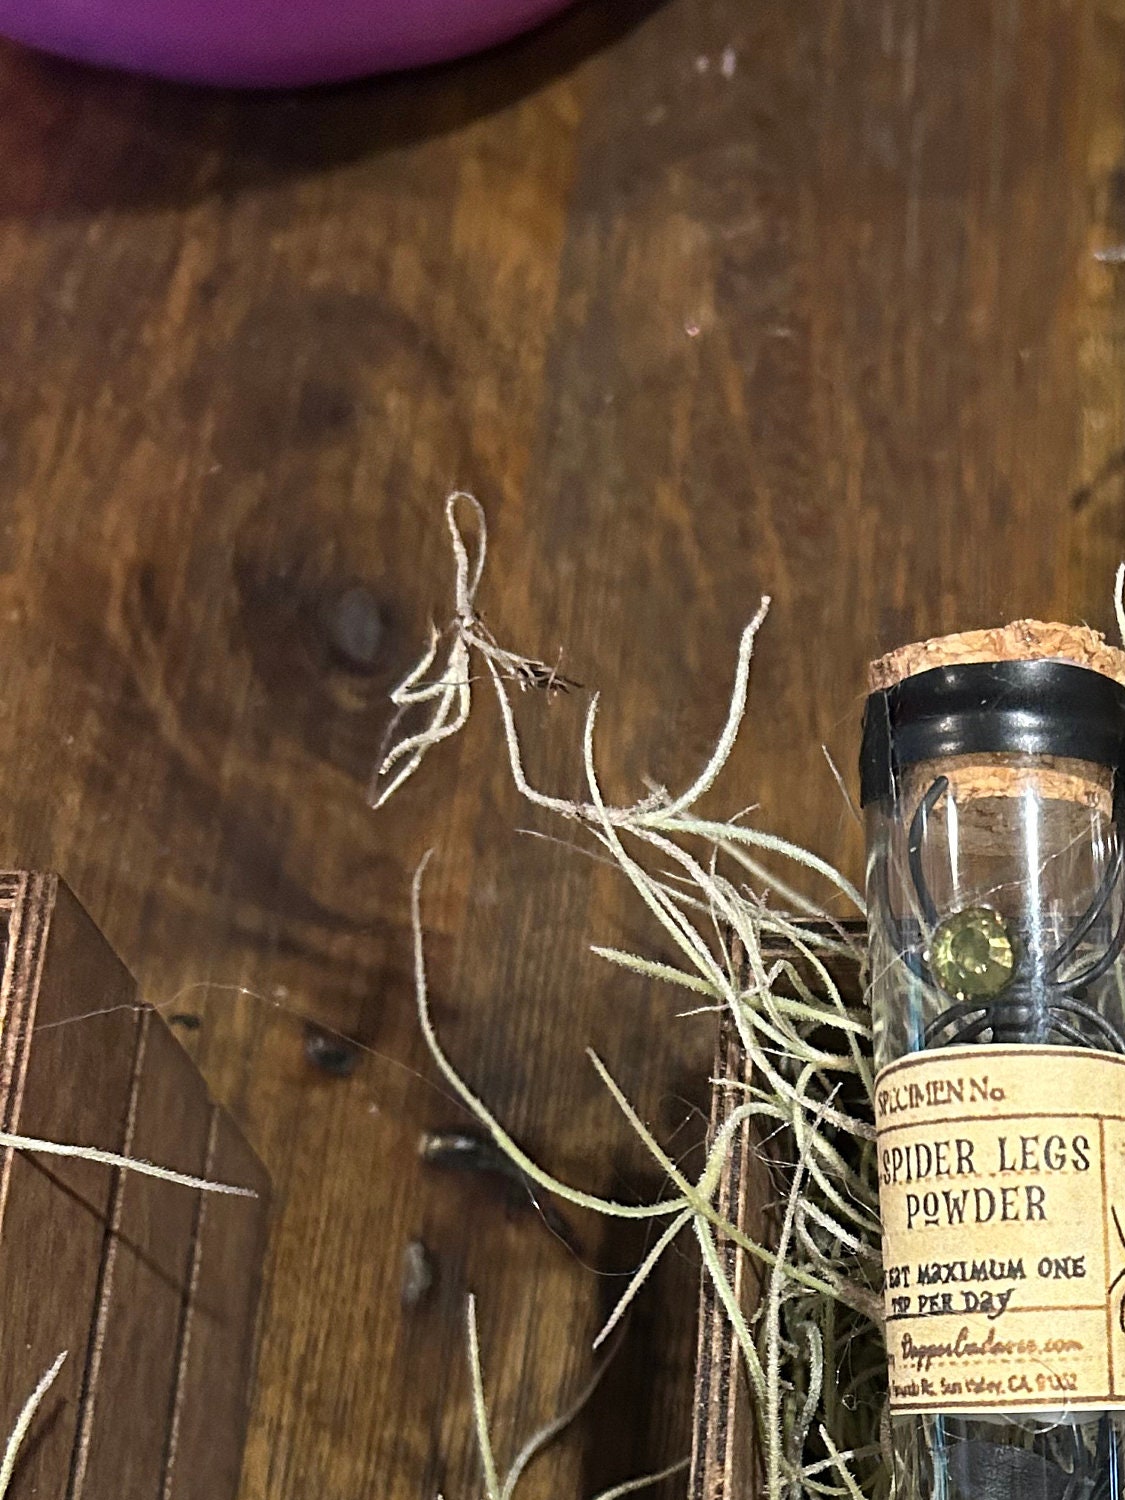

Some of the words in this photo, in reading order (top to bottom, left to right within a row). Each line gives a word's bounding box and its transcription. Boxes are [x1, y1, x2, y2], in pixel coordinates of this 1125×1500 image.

[882, 1138, 977, 1185] SPIDER
[998, 1134, 1091, 1172] LEGS
[905, 1185, 1048, 1230] POWDER
[1038, 1255, 1087, 1280] ONE
[918, 1291, 953, 1315] PER
